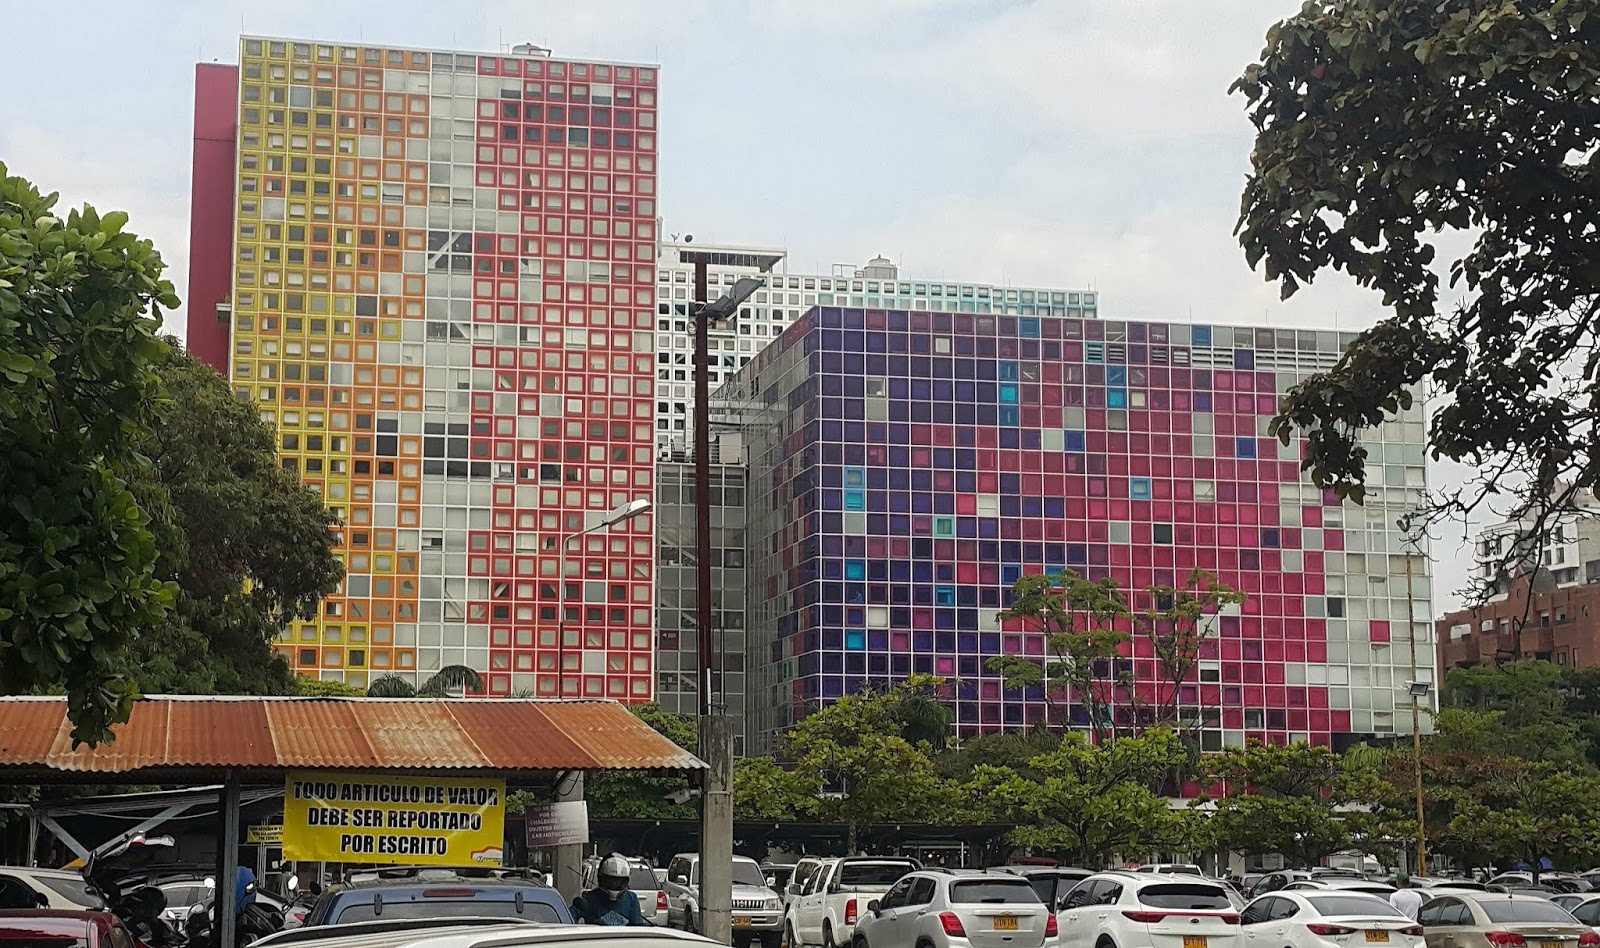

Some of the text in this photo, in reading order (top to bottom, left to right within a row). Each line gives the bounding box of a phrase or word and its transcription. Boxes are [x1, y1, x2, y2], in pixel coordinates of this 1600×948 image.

[293, 781, 498, 806] TODO ARTICULO DE VALOR
[308, 807, 482, 831] DEBE SER REPORTADO
[340, 833, 447, 856] POR ESCRITO
